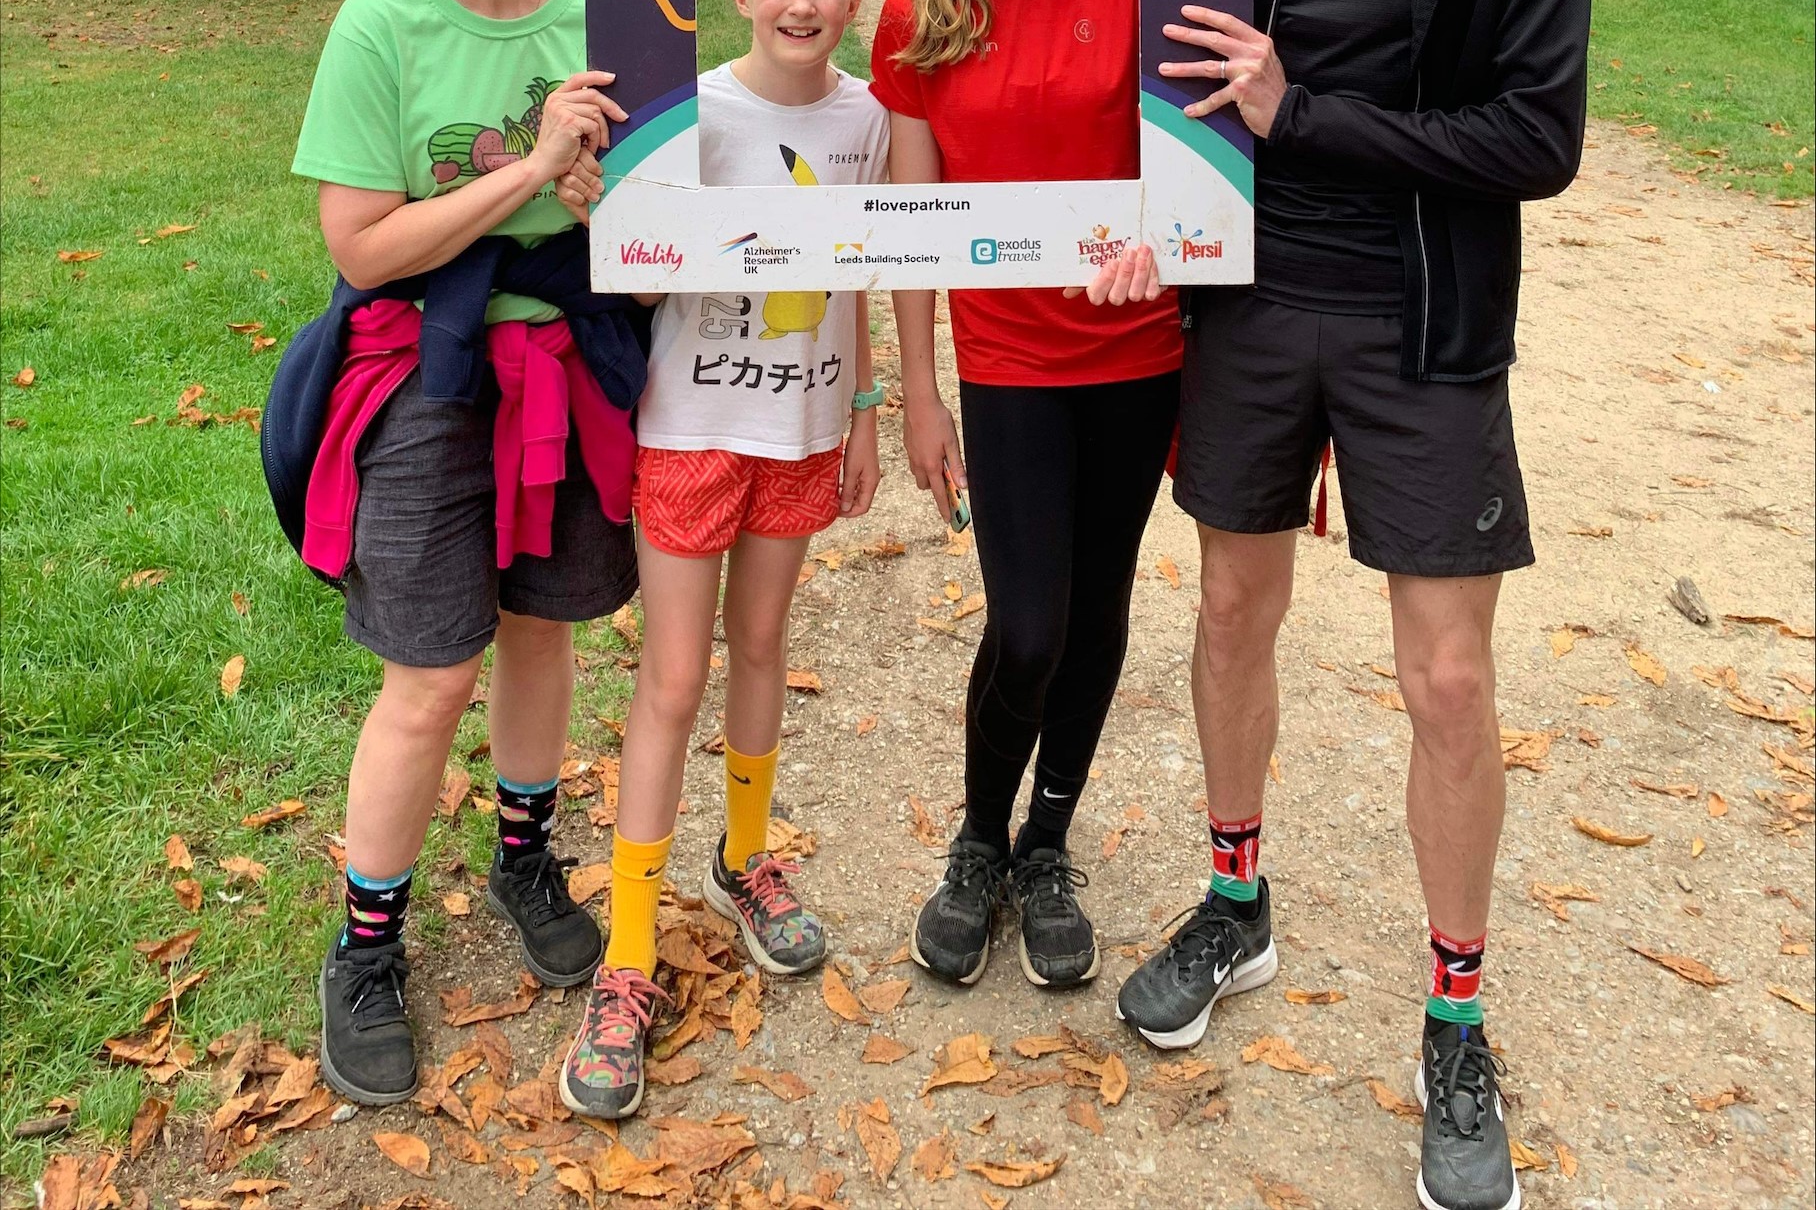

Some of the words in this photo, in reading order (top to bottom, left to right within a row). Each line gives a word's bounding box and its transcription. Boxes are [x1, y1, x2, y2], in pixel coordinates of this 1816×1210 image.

[863, 198, 971, 214] #loveparkrun
[997, 238, 1042, 250] exodus
[1076, 236, 1132, 256] happy
[621, 238, 683, 272] Vitality
[743, 246, 801, 256] Alzheimer's
[997, 250, 1042, 262] travels
[1182, 240, 1223, 263] Persil
[743, 255, 789, 265] Research
[834, 255, 863, 264] Leeds
[864, 254, 903, 265] Building
[904, 254, 940, 264] Society
[743, 265, 759, 275] UK
[692, 353, 842, 394] ピカチュウ
